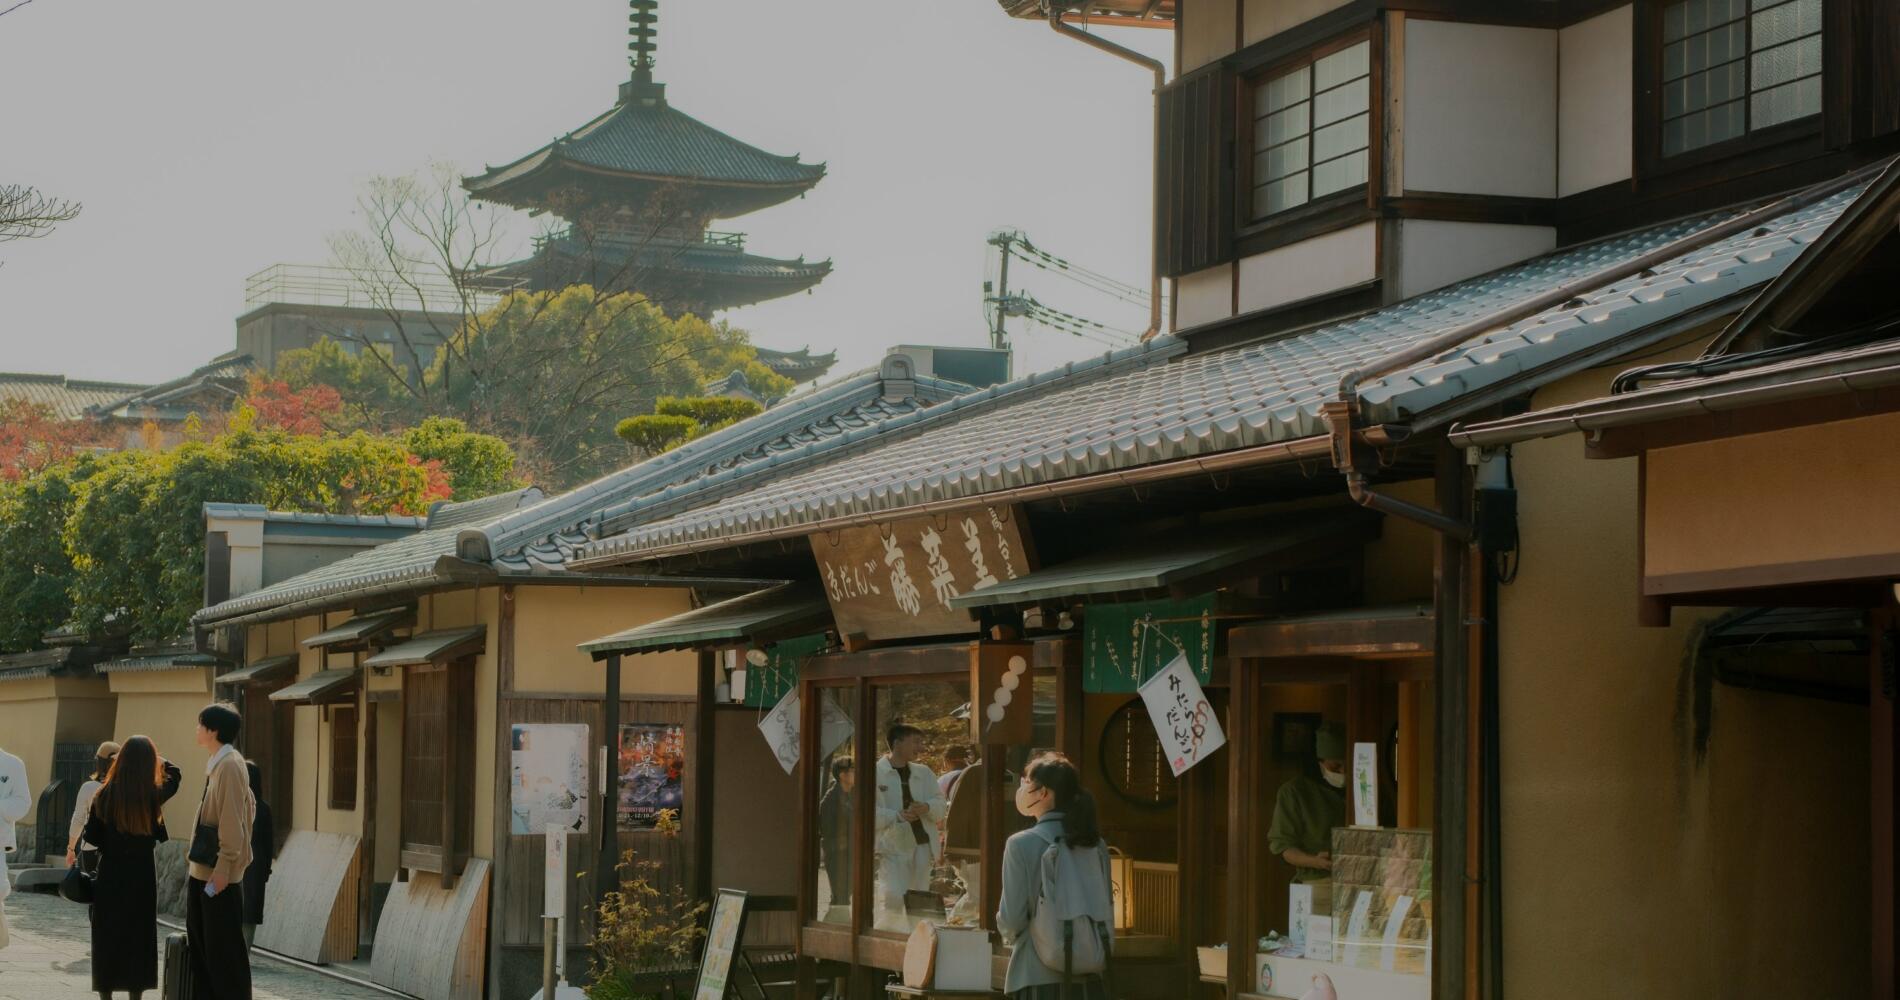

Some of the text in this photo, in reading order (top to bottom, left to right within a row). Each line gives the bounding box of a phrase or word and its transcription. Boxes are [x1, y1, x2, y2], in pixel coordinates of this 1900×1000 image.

[825, 558, 881, 603] 京だんご
[1166, 706, 1192, 754] だんご
[635, 733, 657, 778] 情景
